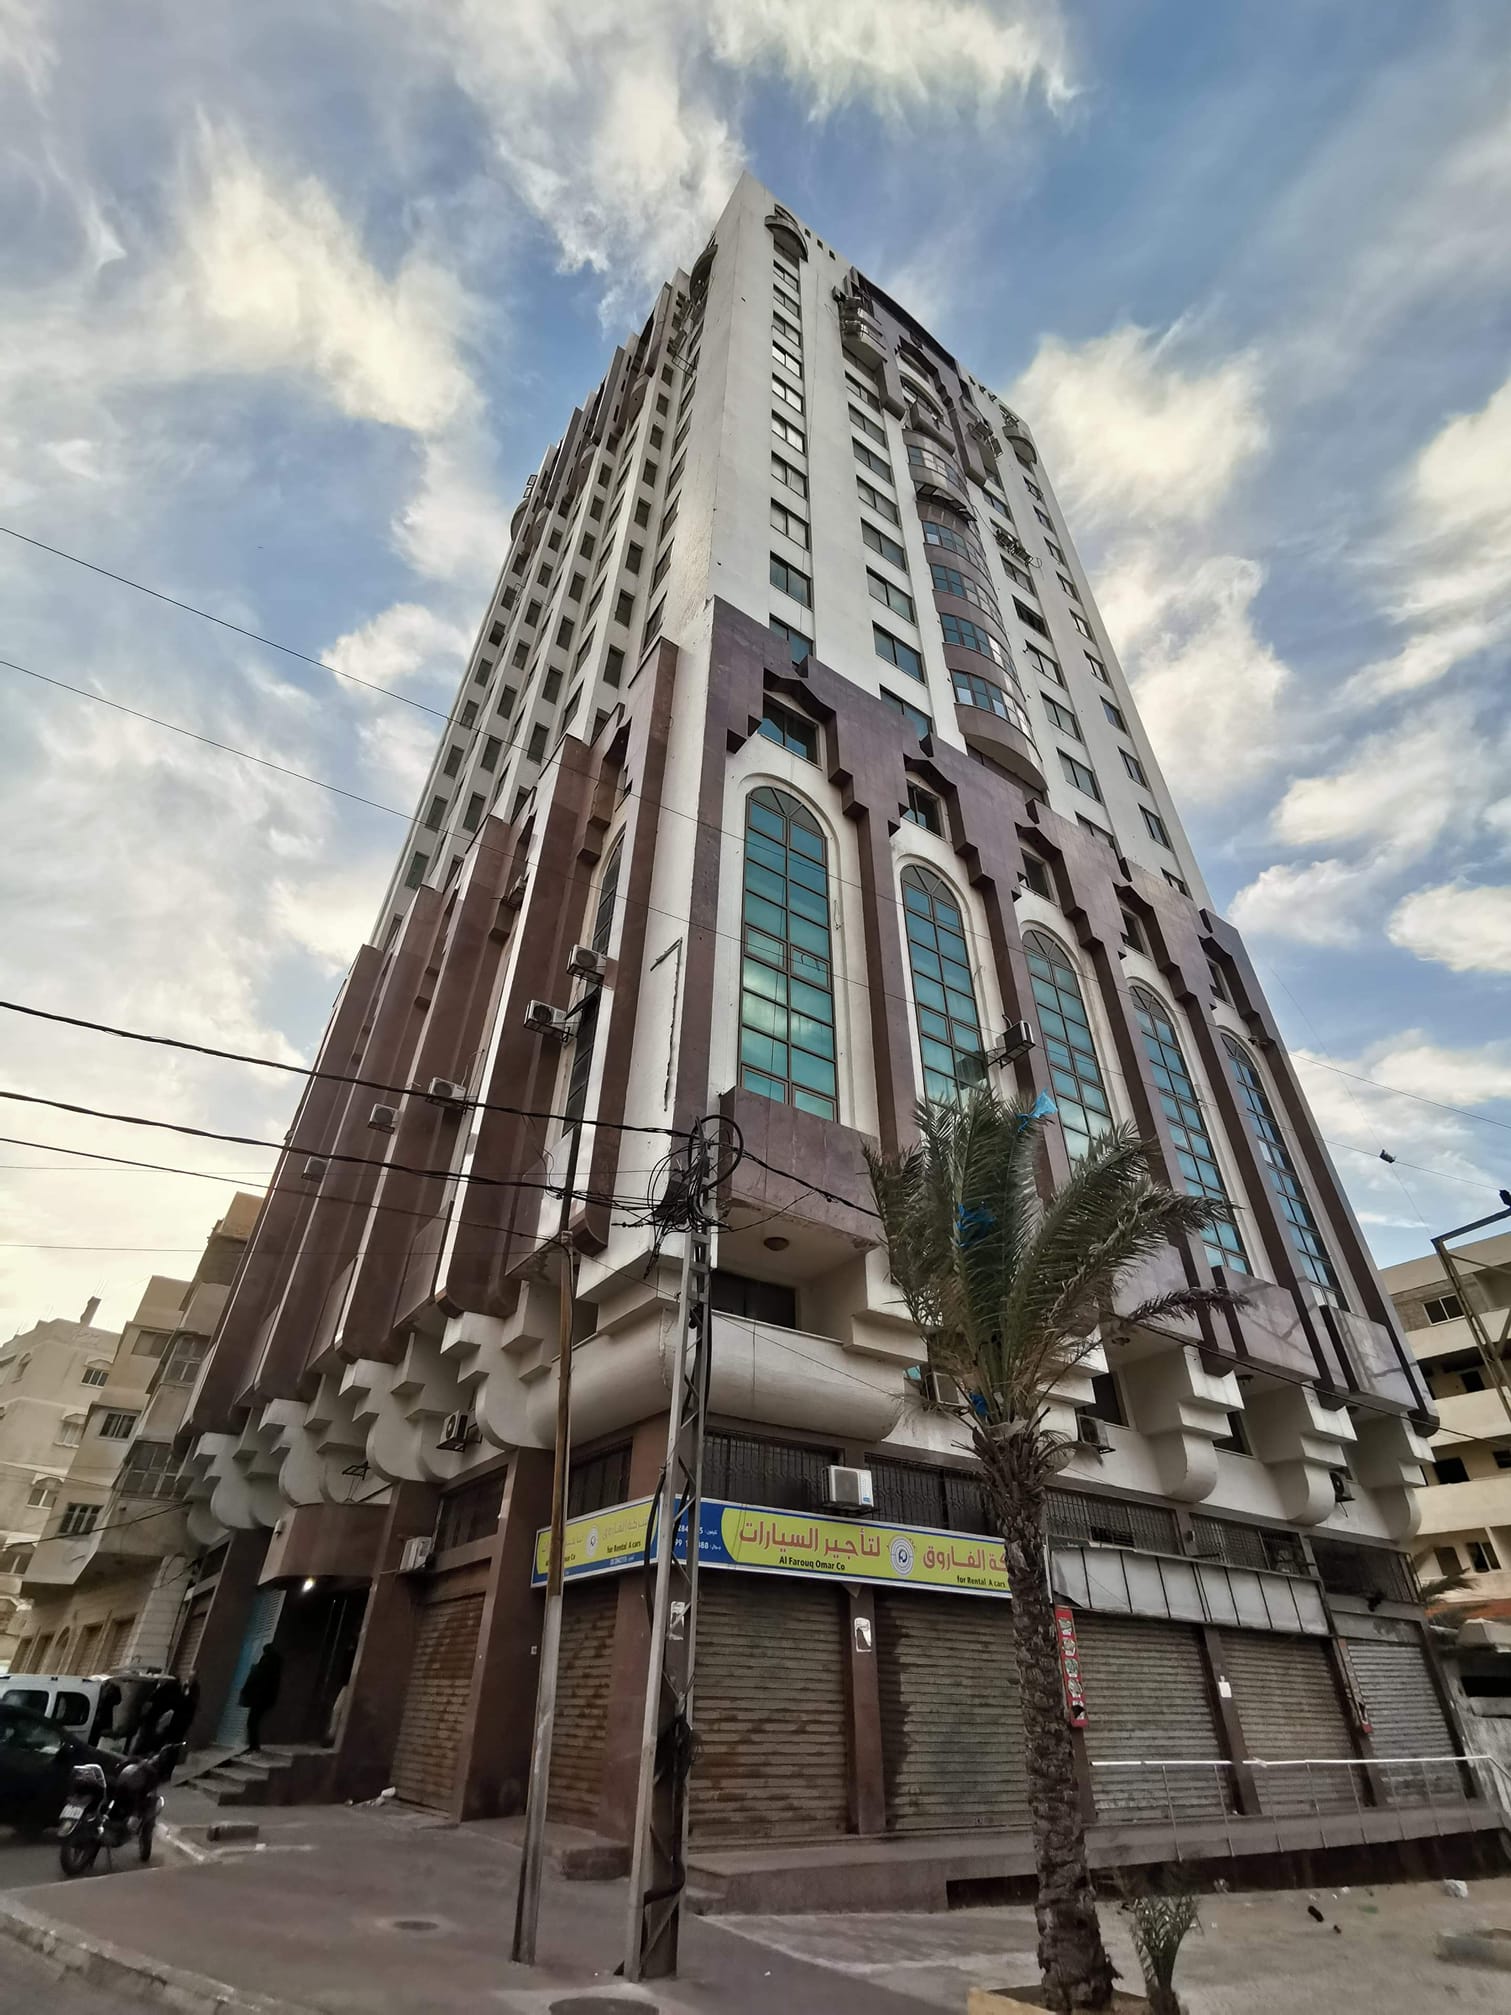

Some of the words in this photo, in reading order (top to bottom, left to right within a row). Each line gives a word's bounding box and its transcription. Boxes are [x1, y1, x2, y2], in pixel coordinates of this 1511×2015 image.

[739, 1521, 819, 1552] السيارات
[824, 1528, 881, 1560] لتأجير
[779, 1556, 788, 1565] Al
[788, 1557, 814, 1569] Farouq
[815, 1560, 835, 1570] Omar
[836, 1562, 845, 1571] Co
[923, 1545, 985, 1571] الفاروق
[957, 1575, 966, 1584] for
[967, 1576, 986, 1585] Rental
[988, 1578, 993, 1587] A
[994, 1580, 1006, 1588] cars
